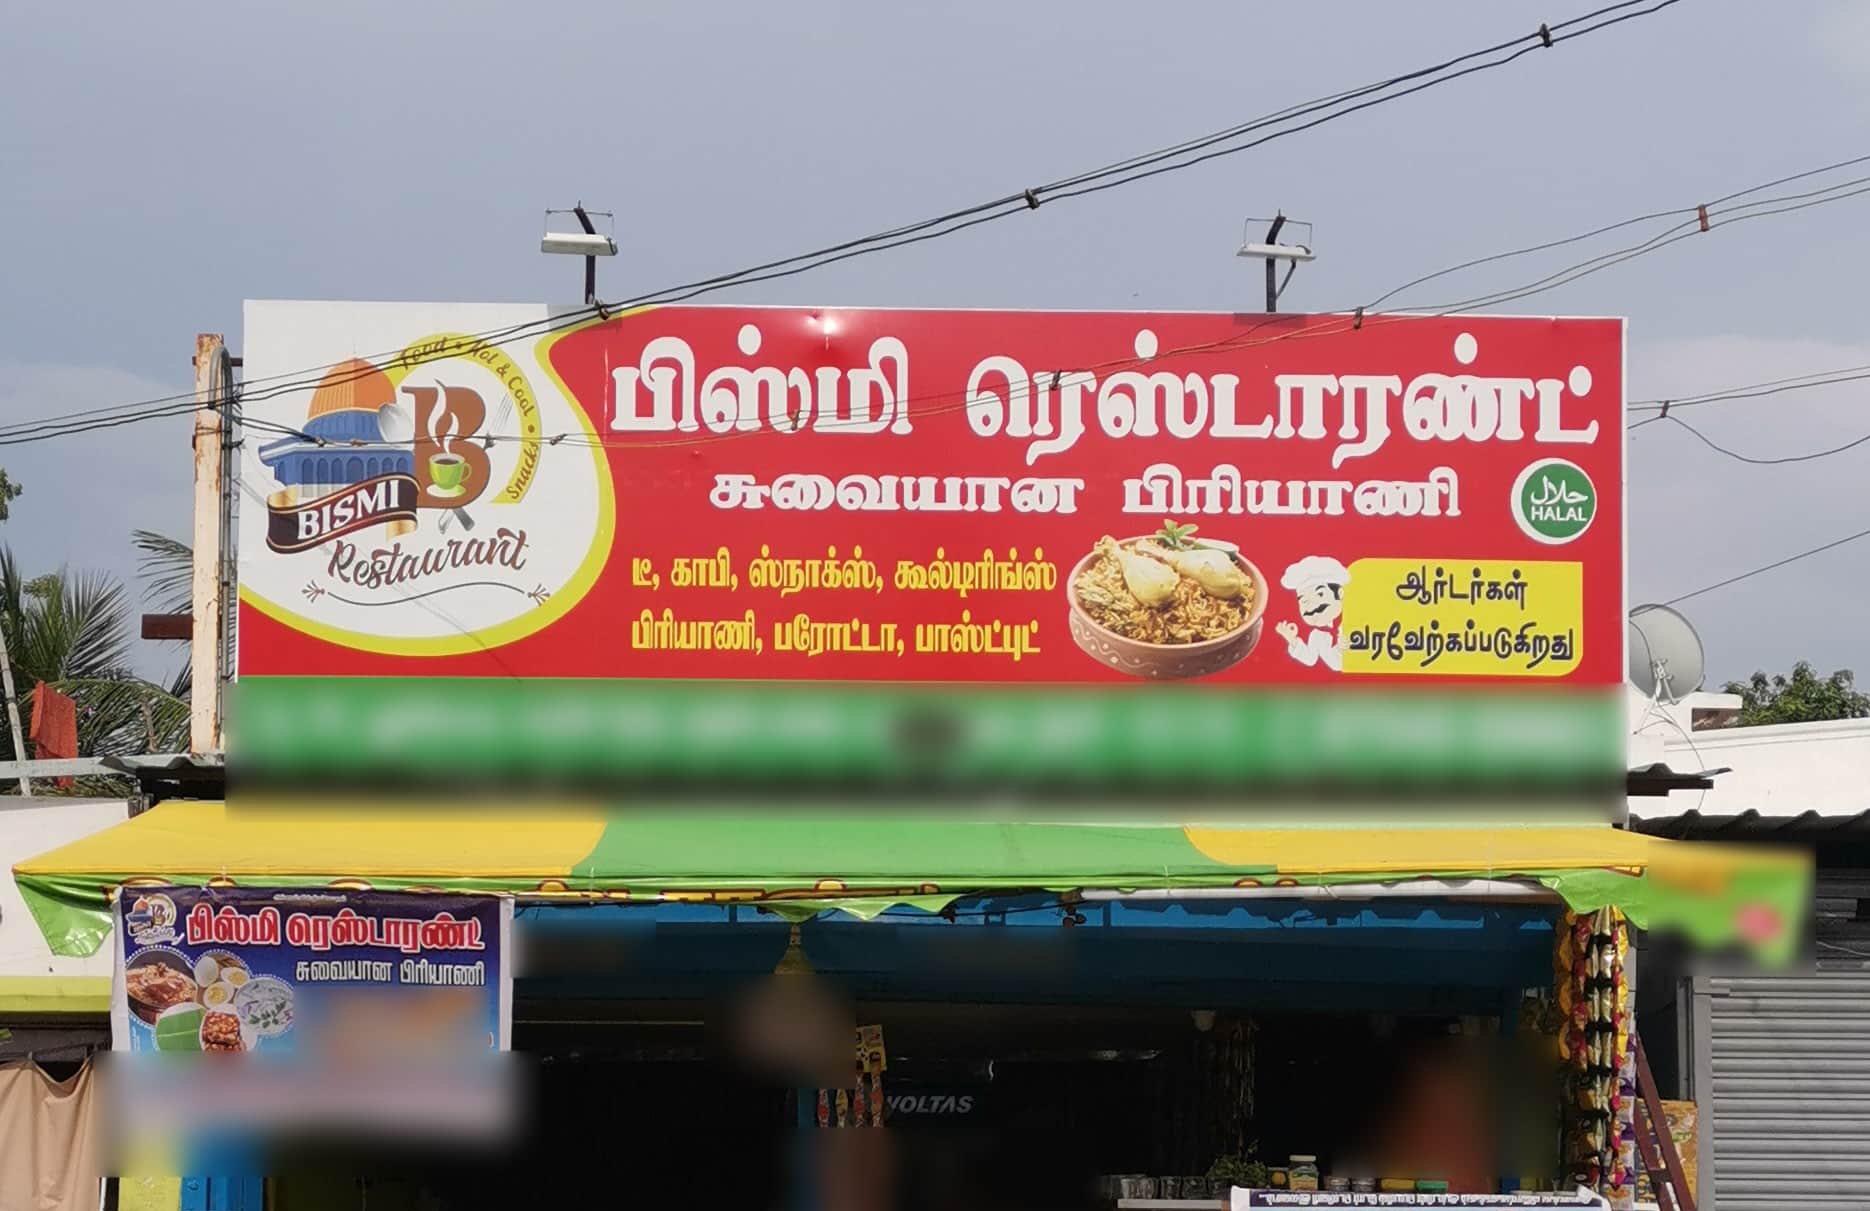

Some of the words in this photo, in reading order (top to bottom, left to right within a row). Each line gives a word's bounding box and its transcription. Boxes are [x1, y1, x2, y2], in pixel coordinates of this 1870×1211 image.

[495, 363, 511, 377] &
[508, 376, 535, 416] Cool
[611, 324, 912, 435] பிஸ்மி
[966, 329, 1599, 470] ரெஸ்டாரண்ட்
[506, 441, 539, 500] Snacks
[709, 471, 1085, 514] சுவையான
[1122, 463, 1462, 517] பிரியாணி
[1531, 475, 1589, 505] حلال
[297, 479, 400, 540] BISMI
[1531, 507, 1588, 522] HALAL
[328, 527, 529, 589] Restaurant
[632, 554, 660, 590] டீ,
[671, 546, 738, 591] காபி,
[749, 544, 884, 598] ஸ்நாக்ஸ்,
[895, 546, 1057, 598] கூல்டிரிங்ஸ்
[1396, 565, 1528, 610] ஆர்டர்கள்
[632, 607, 762, 655] பிரியாணி,
[775, 613, 904, 656] பரோட்டா,
[916, 609, 1040, 661] பாஸ்ட்புட்
[1350, 619, 1574, 669] வரவேற்கப்படுகிறது
[186, 903, 280, 946] பிஸ்மி
[287, 906, 485, 953] ரெஸ்டாரண்ட்
[296, 958, 392, 983] சுவையான
[399, 958, 485, 987] பிரியாணி
[887, 1096, 975, 1113] VOLTAS
